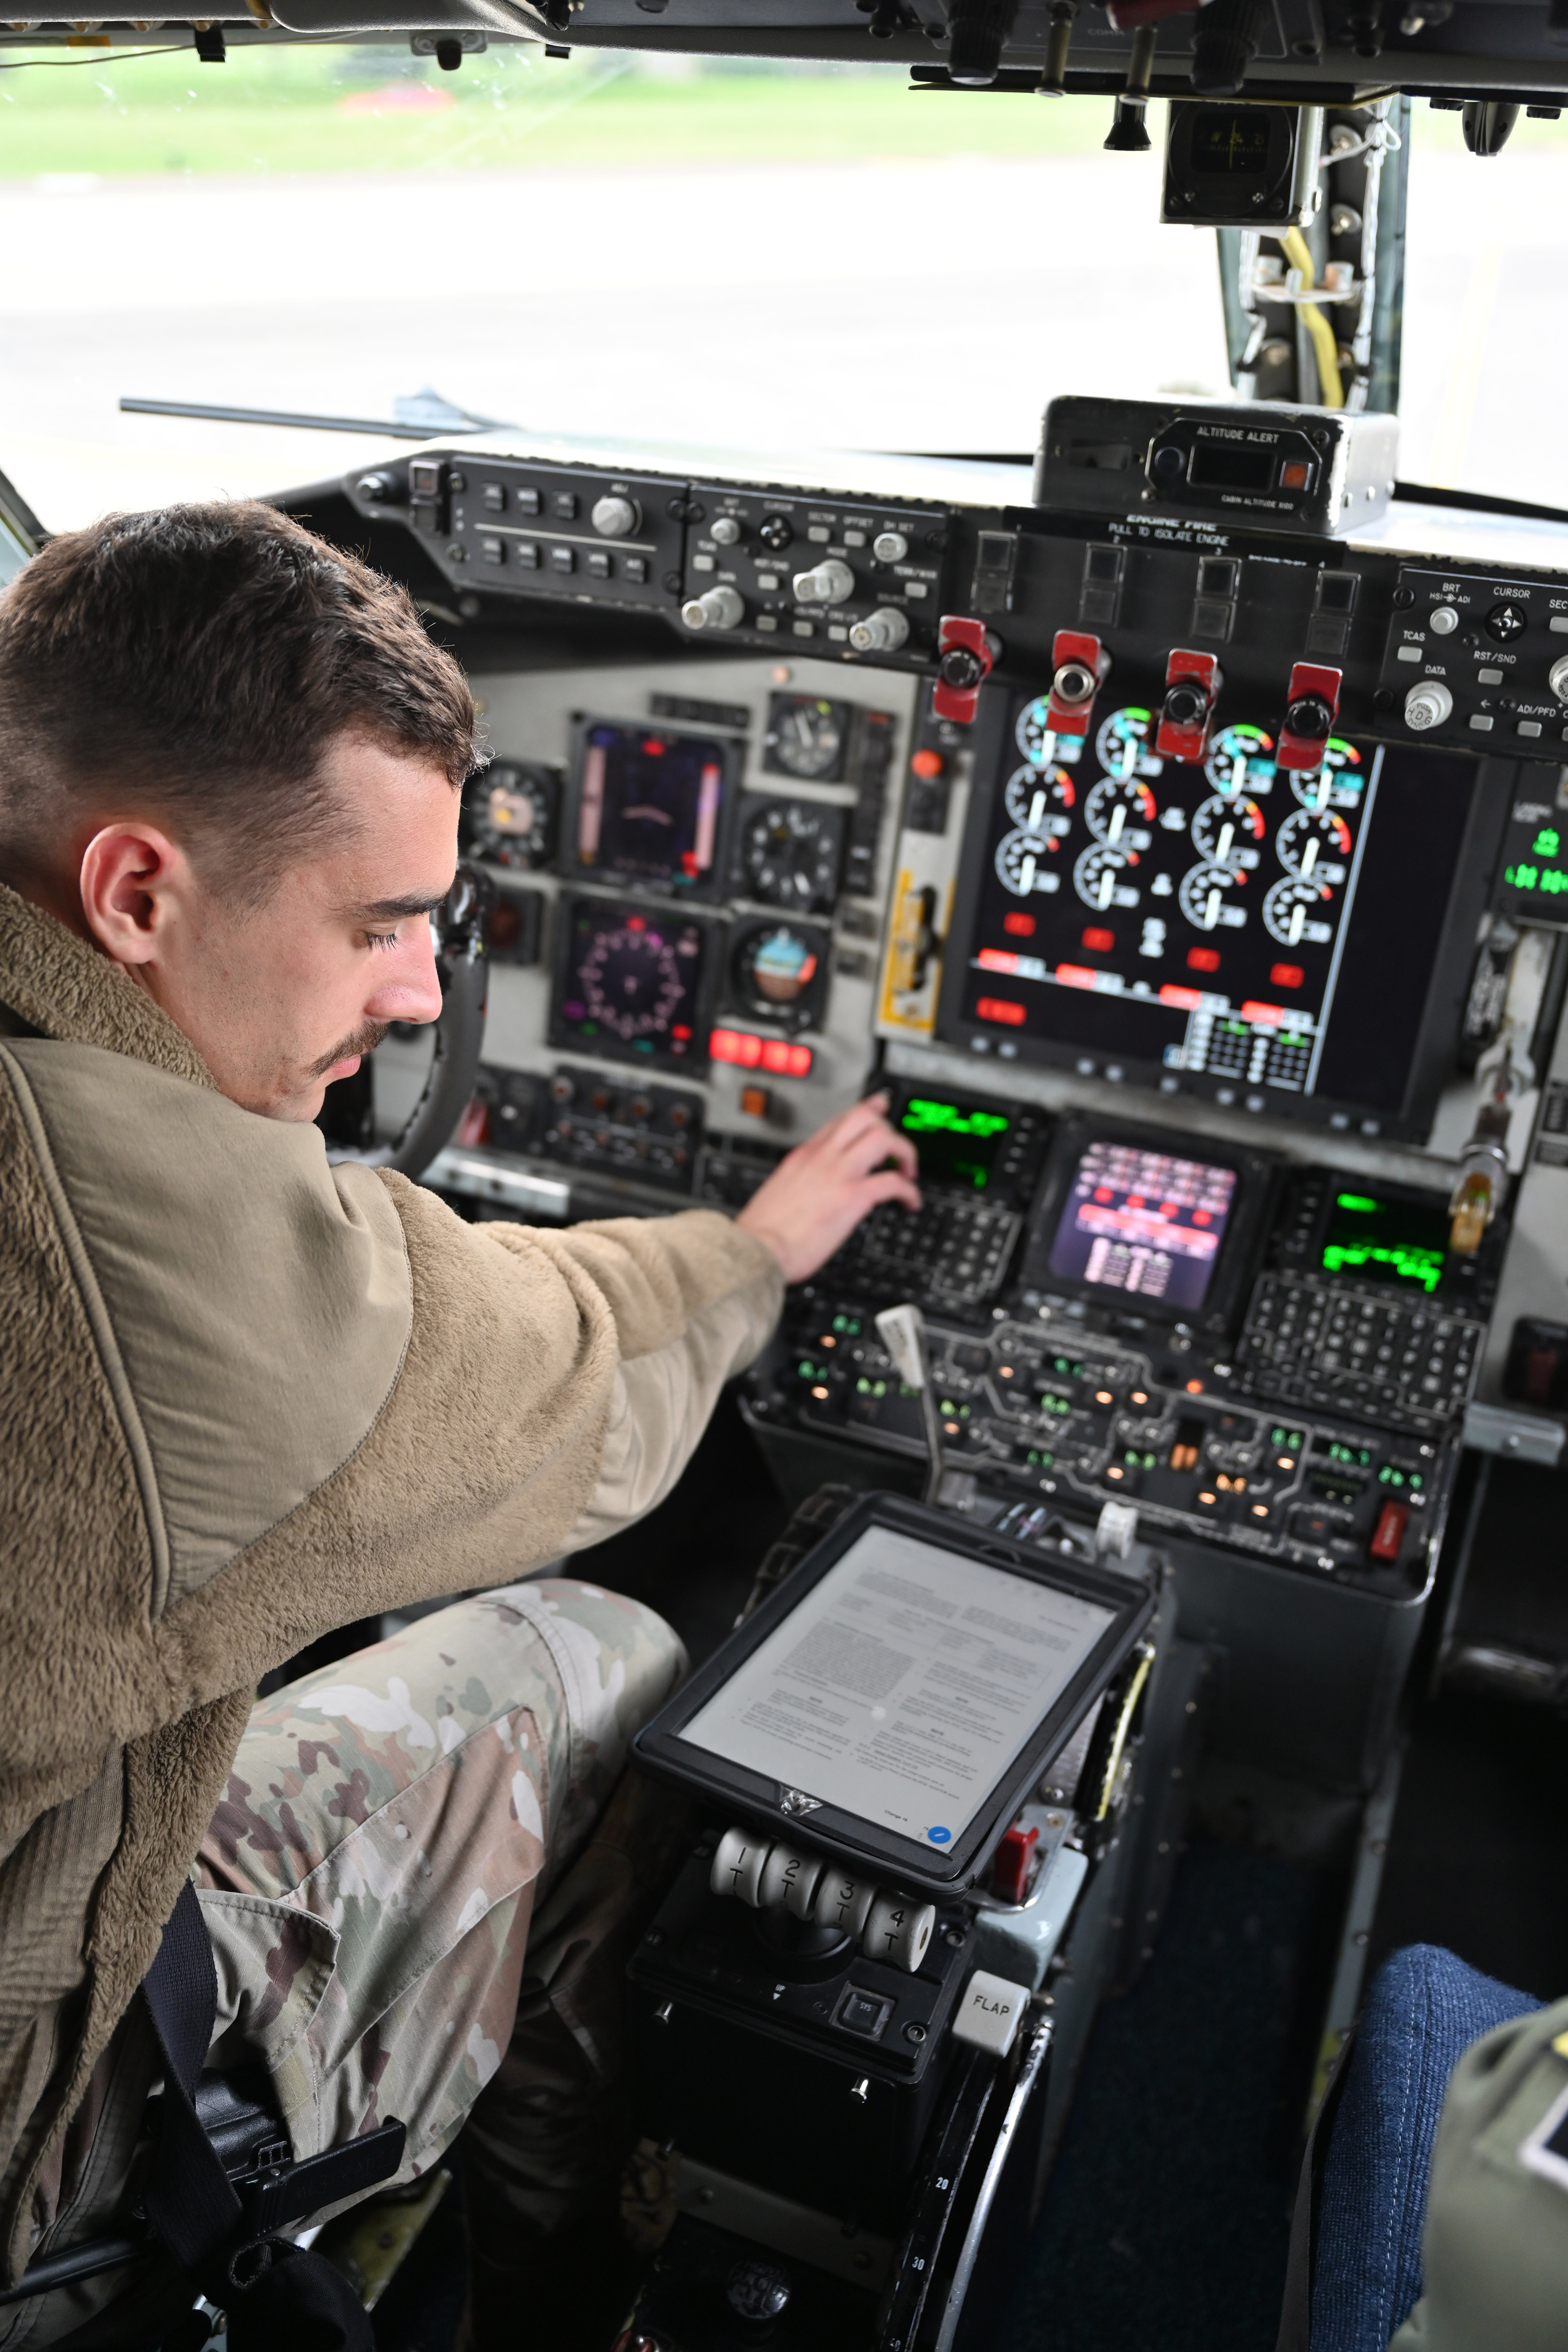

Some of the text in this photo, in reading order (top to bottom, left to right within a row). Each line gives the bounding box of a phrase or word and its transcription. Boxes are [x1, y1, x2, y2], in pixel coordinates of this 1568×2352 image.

[1196, 426, 1280, 444] ALTITUDE ALERT
[1126, 514, 1218, 532] ENGINE FIRE
[1108, 522, 1230, 547] PULL TO ISOLATE ENGINE
[1442, 582, 1461, 593] BRT
[1493, 586, 1531, 599] CURSOR
[1457, 595, 1471, 604] ADI
[1549, 599, 1568, 610] SEC
[1403, 630, 1425, 642] TCAS
[1473, 650, 1517, 664] RST/SND
[1425, 664, 1446, 675] DATA
[1517, 704, 1556, 717] ADI/PFD
[884, 1810, 901, 1819] Change
[784, 1859, 800, 1878] 2
[781, 1879, 794, 1898] T
[840, 1880, 854, 1900] 3
[836, 1902, 850, 1921] T
[891, 1909, 904, 1927] 4
[884, 1932, 899, 1951] T
[972, 1995, 1010, 2016] FLAP
[935, 2177, 949, 2190] 20
[911, 2256, 925, 2271] 30
